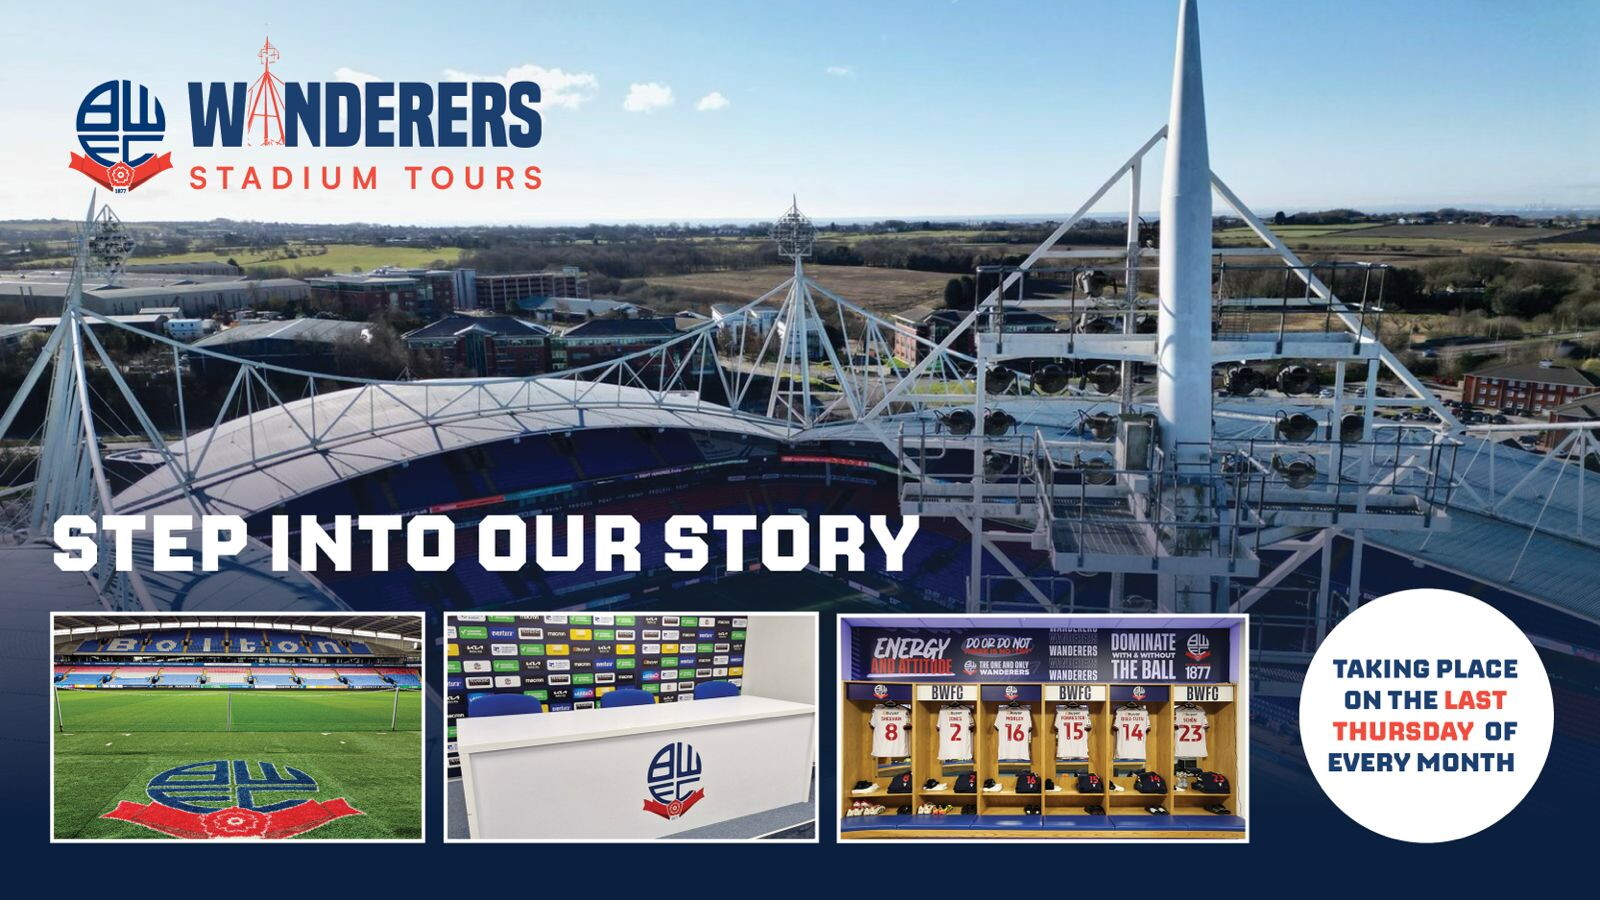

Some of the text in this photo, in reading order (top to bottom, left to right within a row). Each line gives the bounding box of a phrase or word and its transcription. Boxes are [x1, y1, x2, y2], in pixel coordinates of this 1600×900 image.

[873, 637, 951, 660] ENERGY
[966, 637, 1033, 649] DO OR DO NOT
[1111, 633, 1176, 651] DOMINATE
[1049, 645, 1098, 657] WANDERERS
[871, 658, 953, 674] AND ATTITUDE
[980, 661, 1029, 669] THE ONE AND ONLY
[1111, 660, 1176, 680] THE BALL
[1185, 666, 1211, 679] 1877
[1049, 669, 1098, 681] WANDERERS
[932, 685, 963, 700] BWFC
[1059, 685, 1092, 700] BWFC
[1186, 686, 1219, 701] BWFC
[885, 723, 898, 741] 8
[950, 724, 962, 741] 2
[1005, 723, 1025, 742] 16
[1063, 722, 1083, 740] 15
[1122, 724, 1144, 741] 14
[1178, 725, 1203, 742] 23
